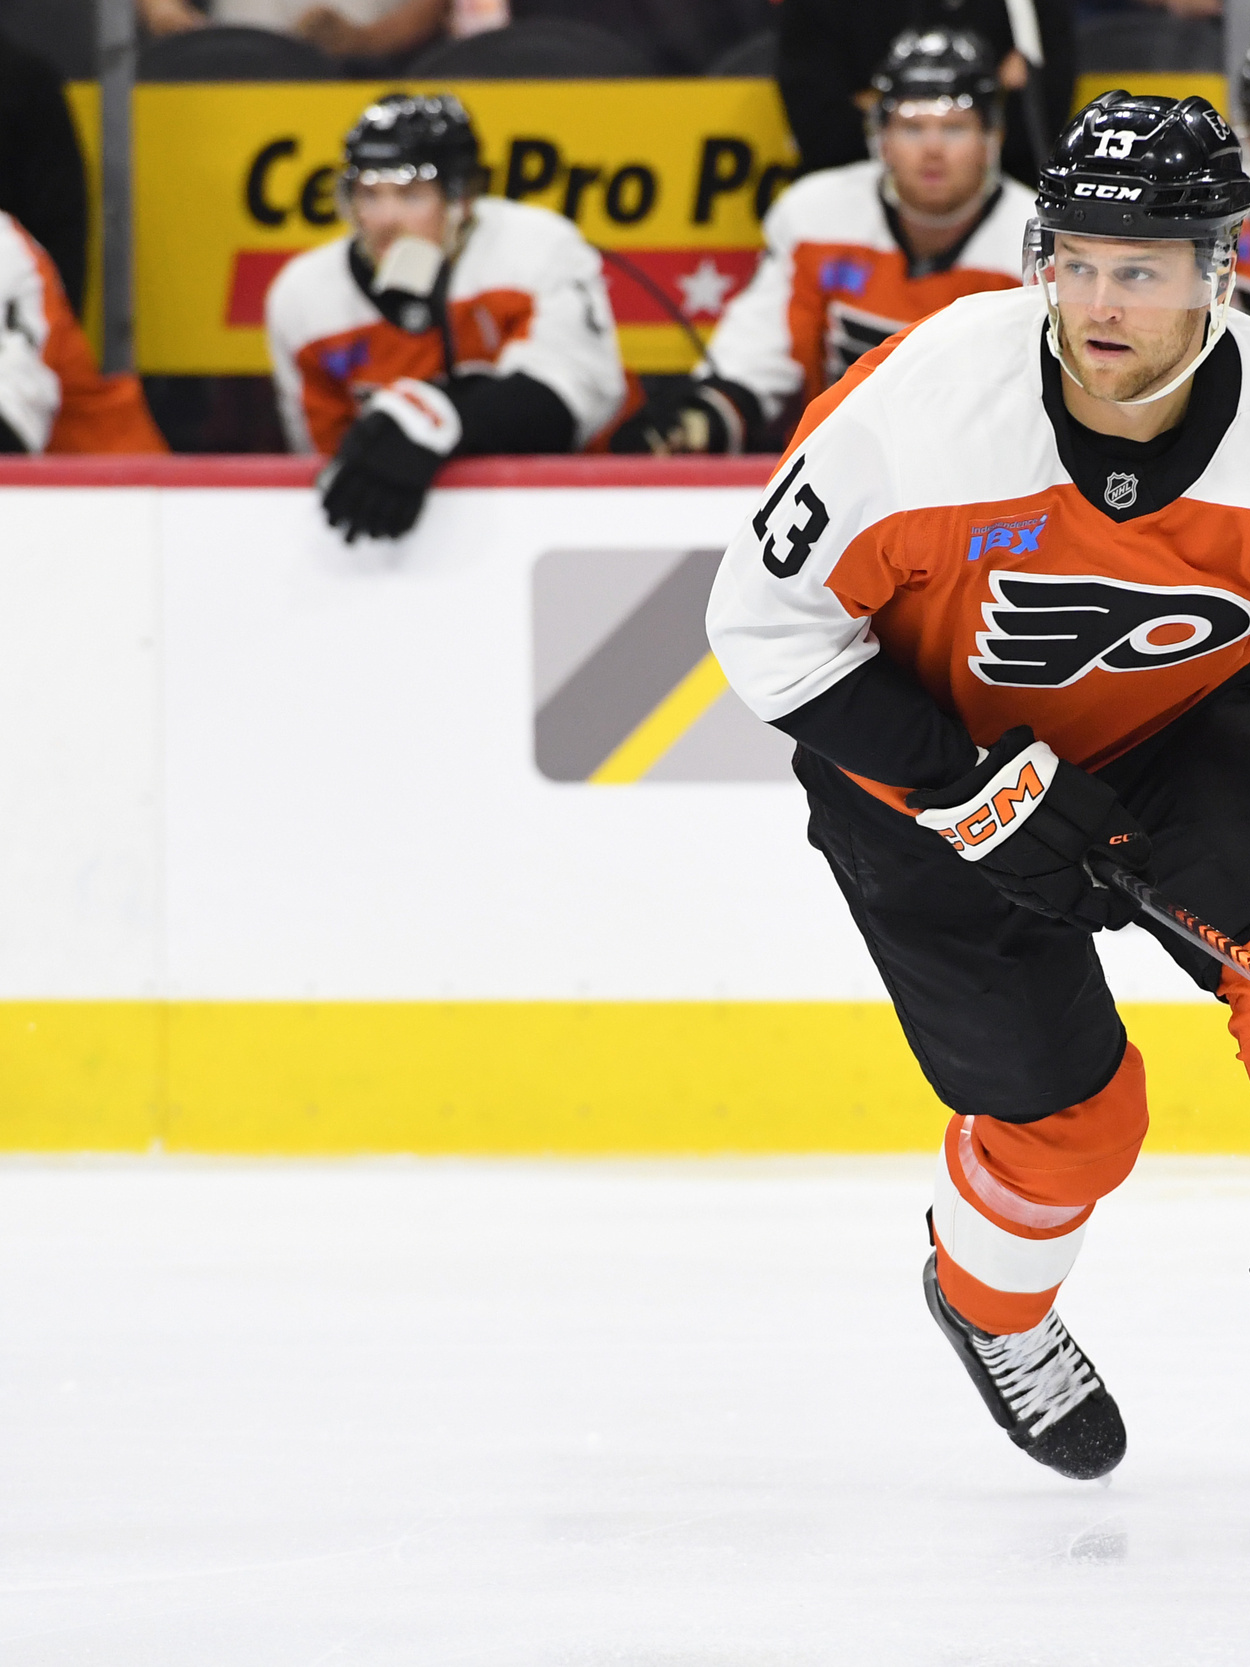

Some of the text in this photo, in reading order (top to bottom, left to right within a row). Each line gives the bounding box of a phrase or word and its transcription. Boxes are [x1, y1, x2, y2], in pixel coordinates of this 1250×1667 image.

[1094, 129, 1137, 160] 13
[245, 137, 655, 227] CePro
[1074, 182, 1143, 201] CCM
[1111, 482, 1132, 501] NHL
[752, 453, 830, 579] 13
[967, 521, 1046, 561] IBX
